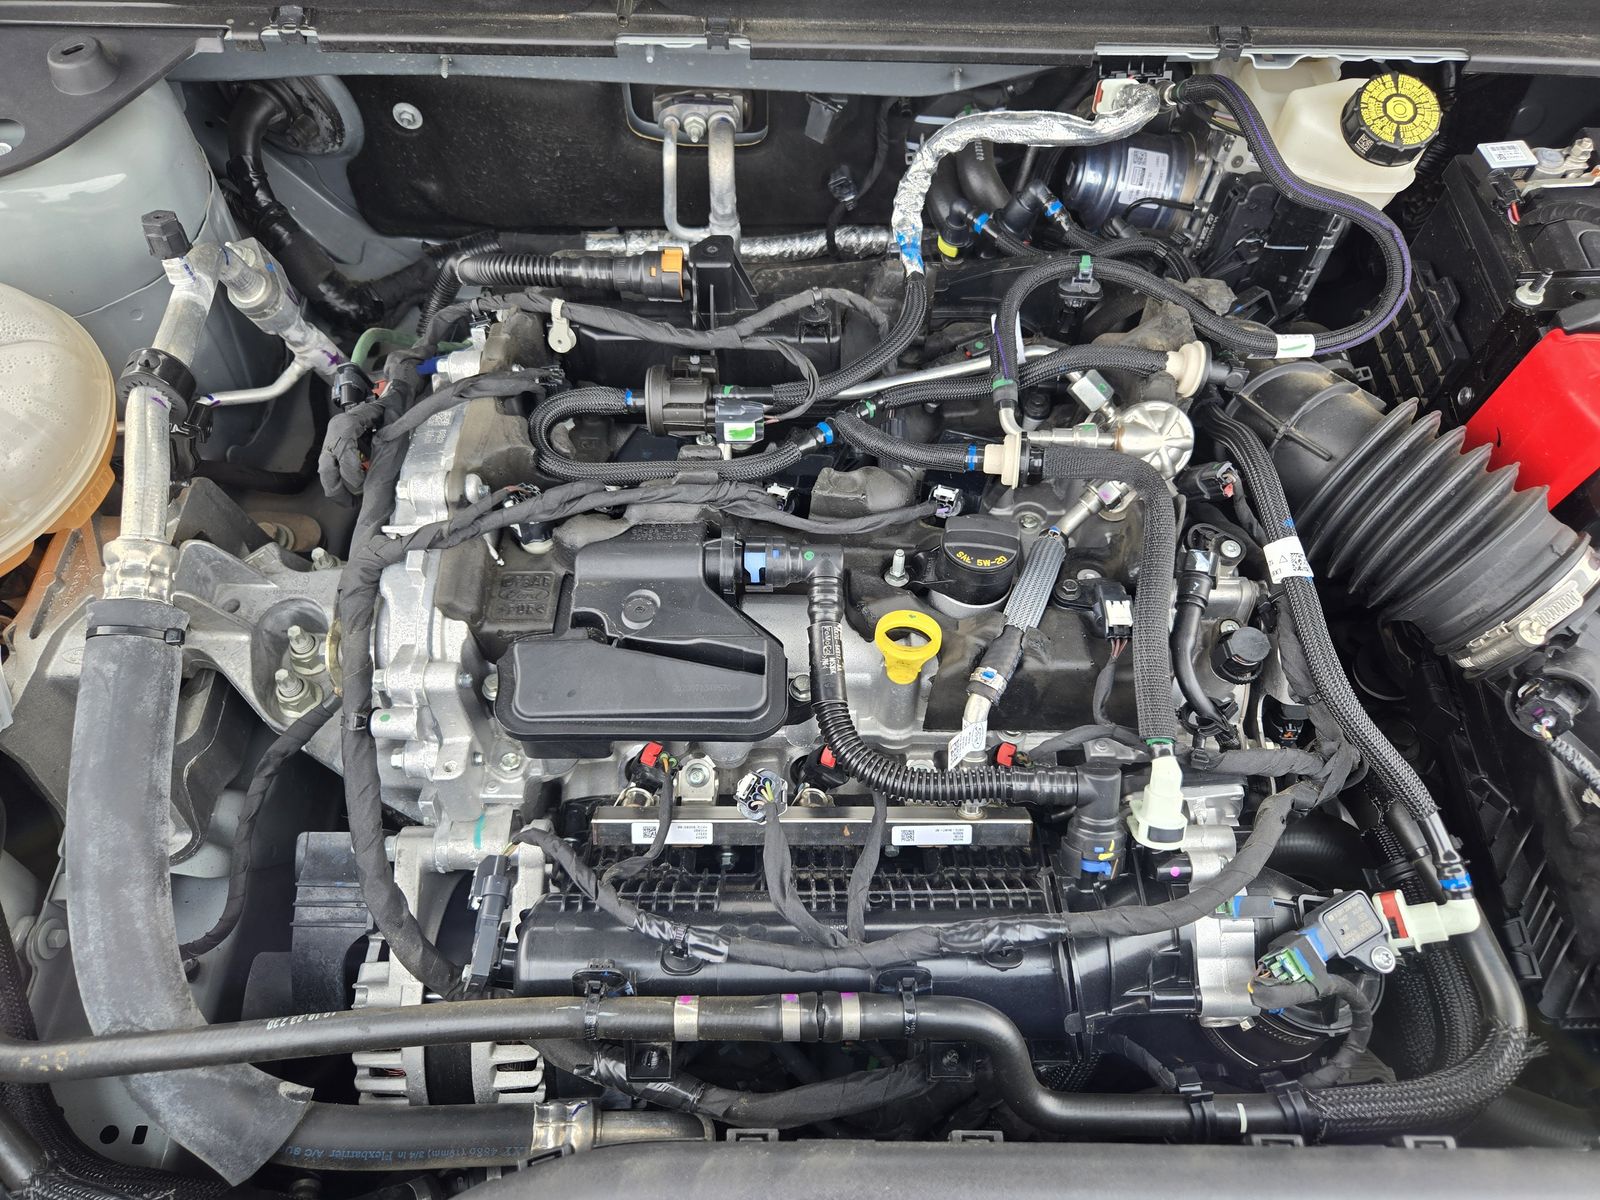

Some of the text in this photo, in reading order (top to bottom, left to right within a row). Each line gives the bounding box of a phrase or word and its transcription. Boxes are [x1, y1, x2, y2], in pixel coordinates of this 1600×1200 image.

[976, 555, 1008, 567] 5W-20
[822, 626, 833, 654] FoMoCo
[303, 1148, 325, 1158] A/C
[328, 1149, 393, 1163] Flexbarrier
